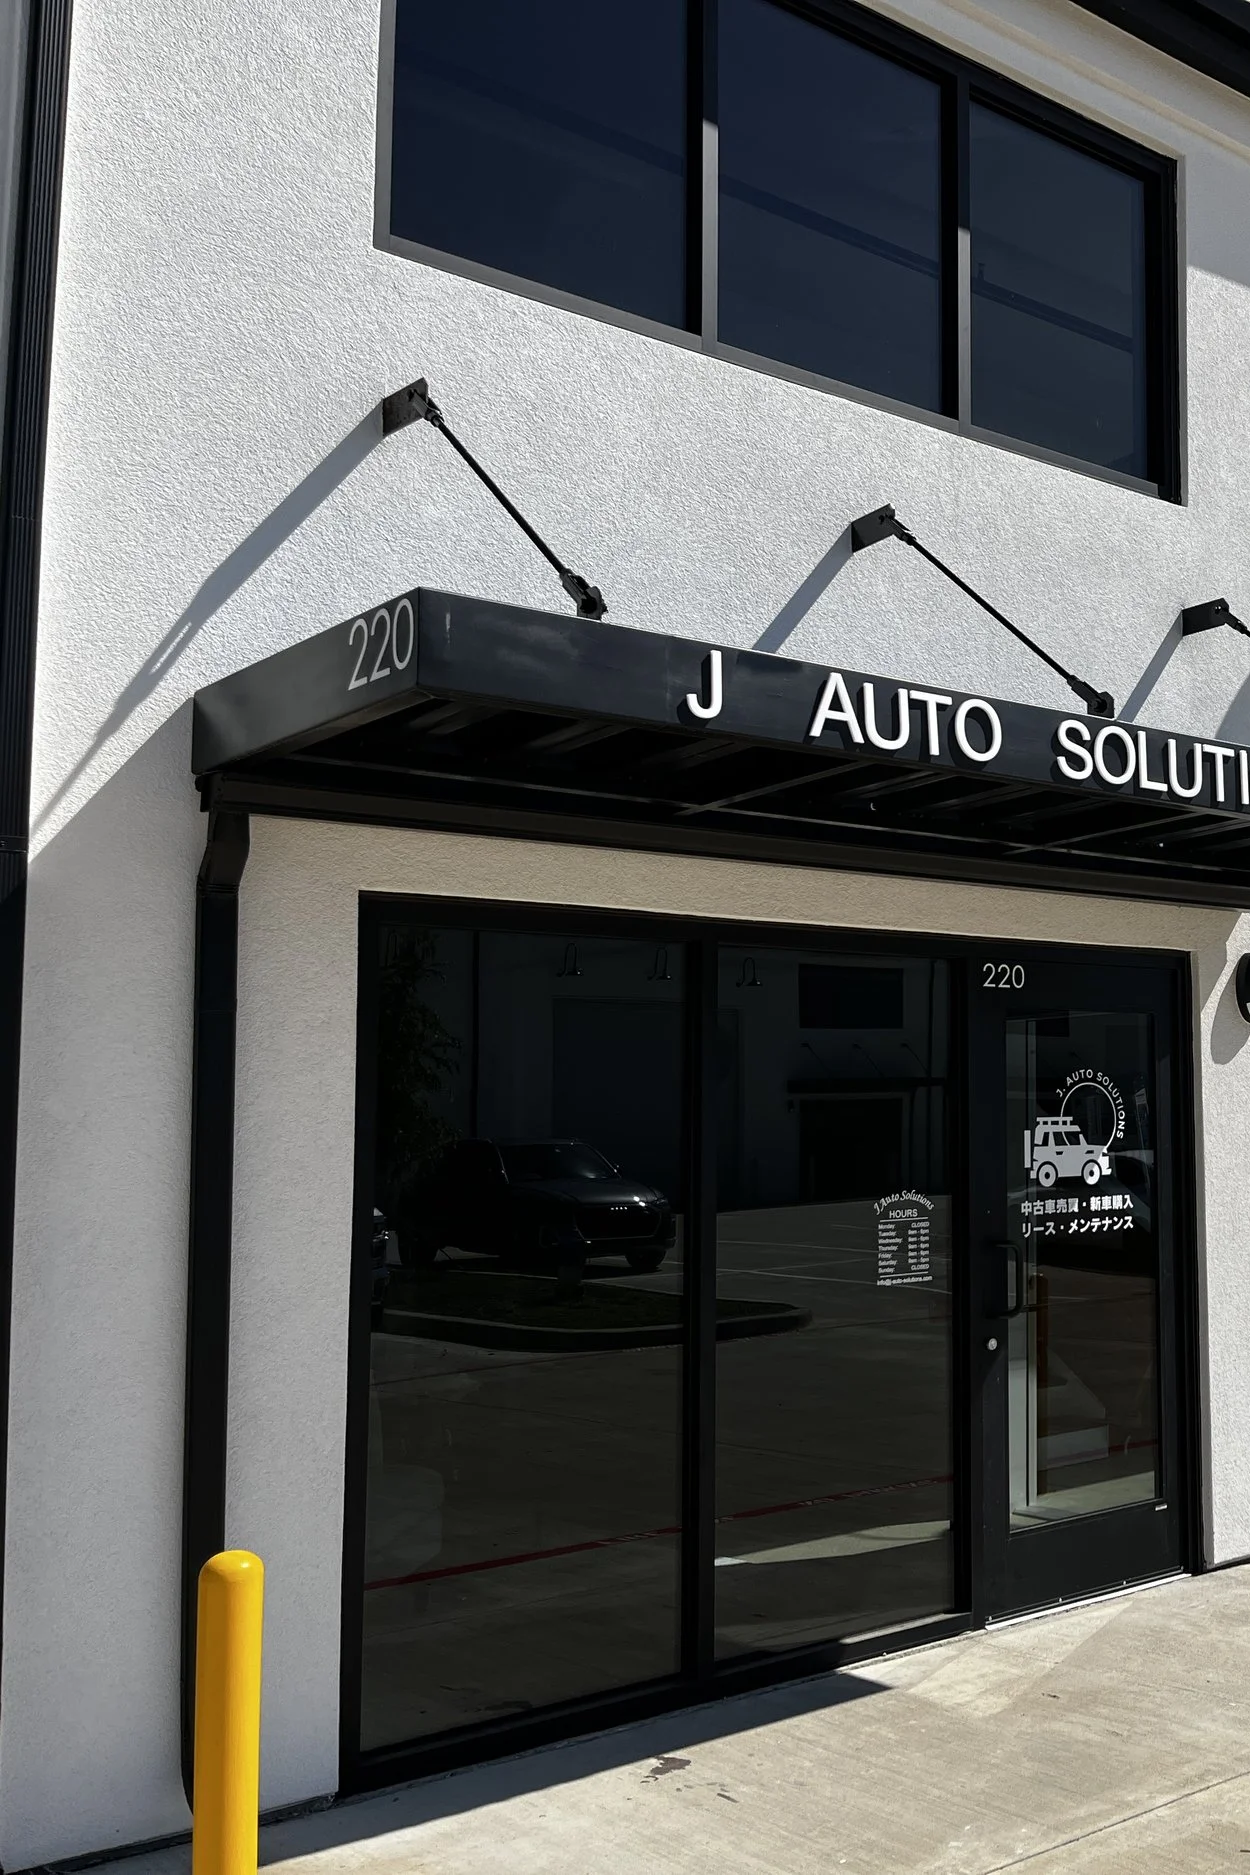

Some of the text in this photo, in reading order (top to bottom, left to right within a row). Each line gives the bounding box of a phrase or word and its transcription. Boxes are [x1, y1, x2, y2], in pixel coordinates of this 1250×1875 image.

[348, 598, 414, 692] 220
[686, 650, 723, 719] J
[809, 672, 1002, 763] AUTO
[983, 963, 1025, 989] 220
[1066, 1069, 1093, 1087] AUTO
[1096, 1071, 1126, 1139] SOLUTIONS
[879, 1193, 900, 1212] Auto
[899, 1189, 935, 1210] Solutions
[889, 1208, 918, 1219] HOURS
[910, 1263, 930, 1271] CLOSED
